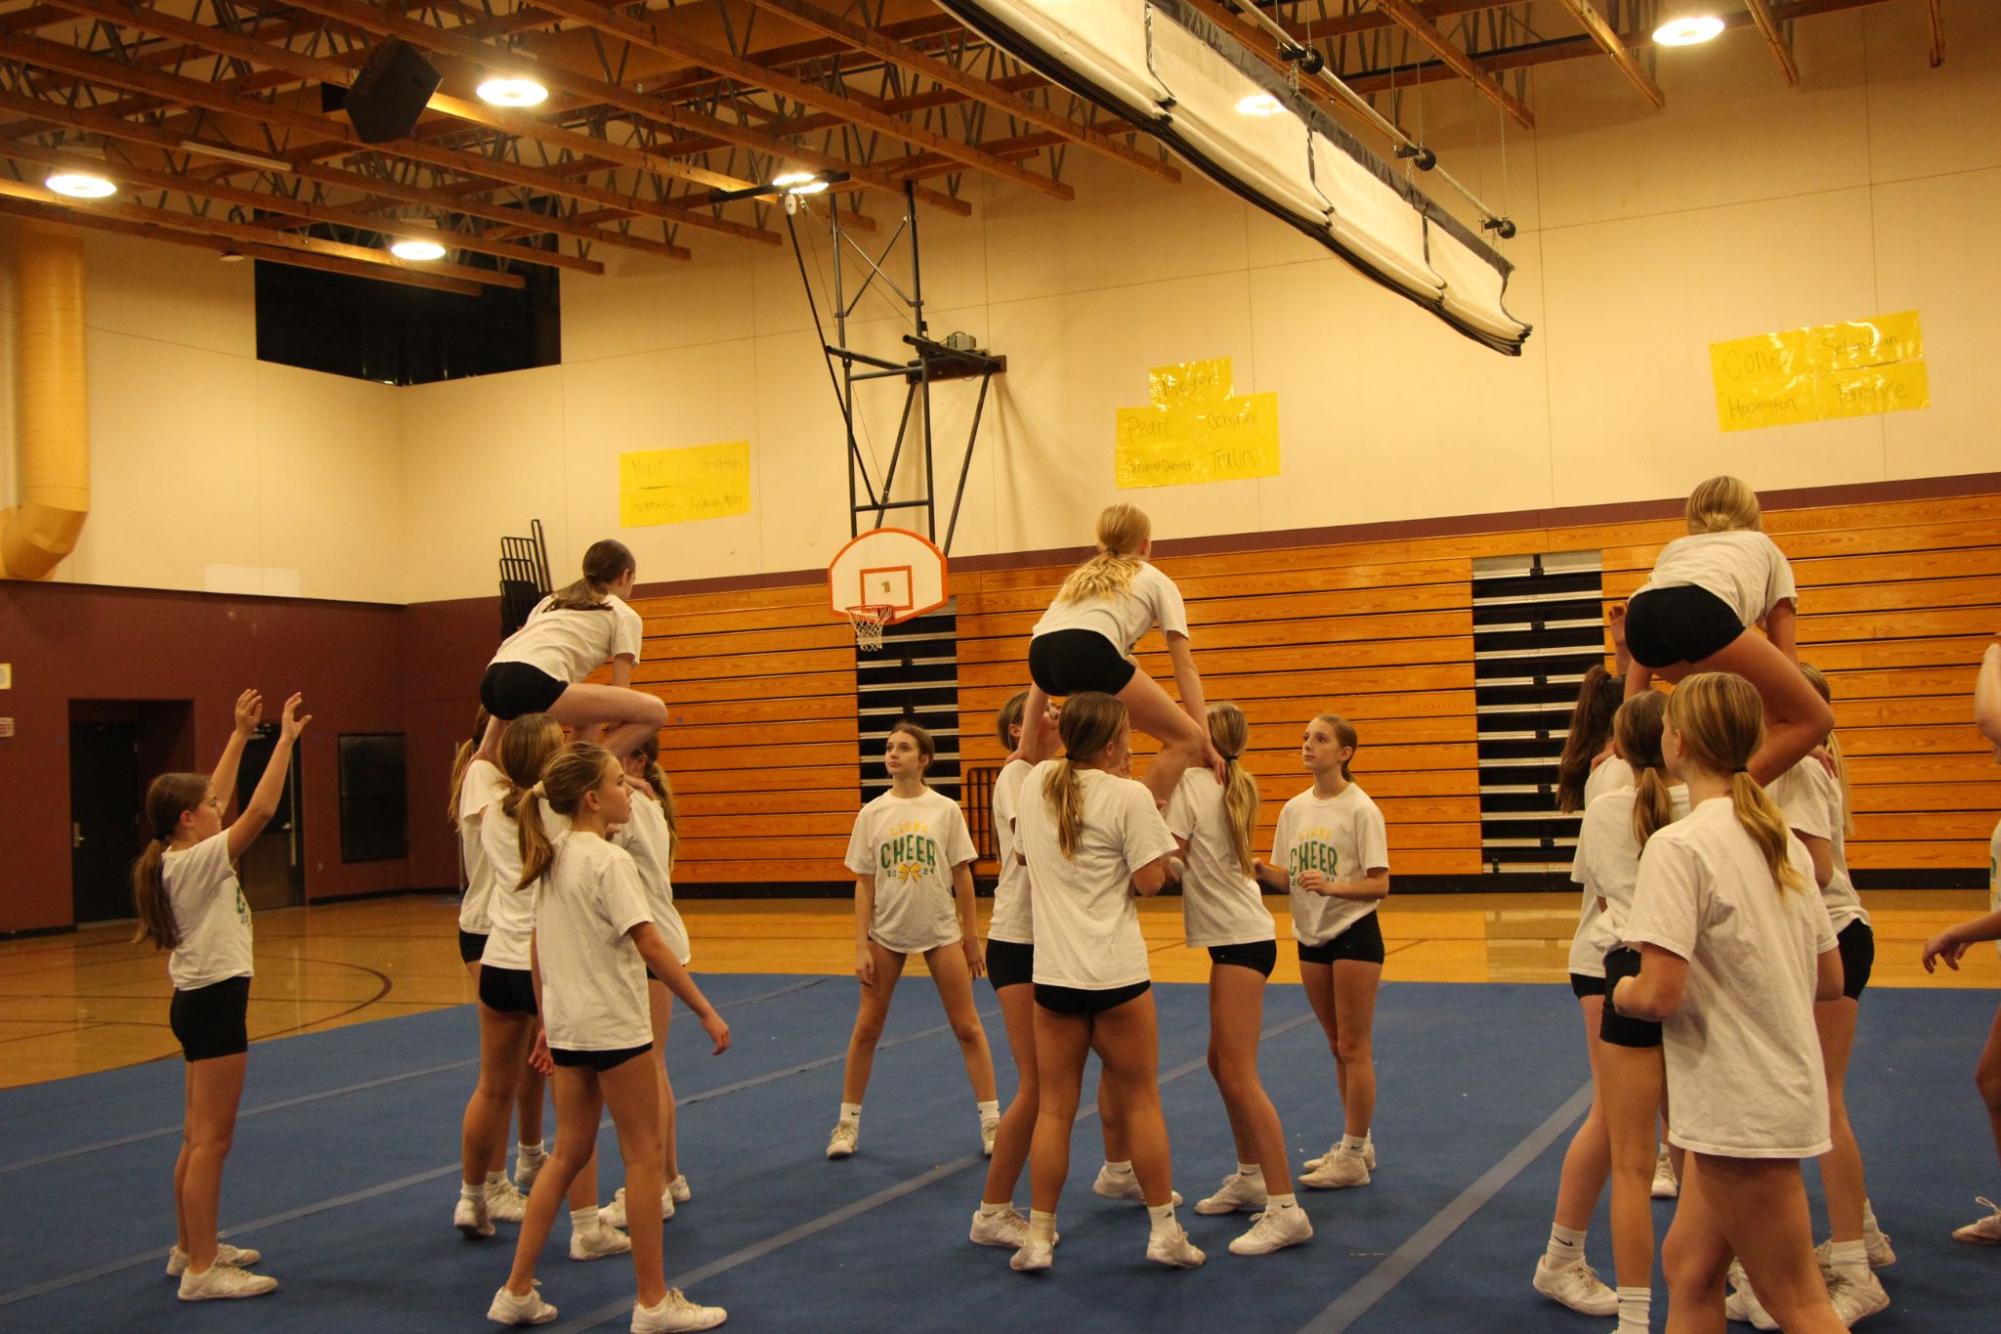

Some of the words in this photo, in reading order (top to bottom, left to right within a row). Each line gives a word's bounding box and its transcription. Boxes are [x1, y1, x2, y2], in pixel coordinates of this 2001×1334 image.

[1126, 415, 1174, 444] Pearl
[881, 834, 936, 868] CHEER
[1289, 840, 1338, 877] CHEER
